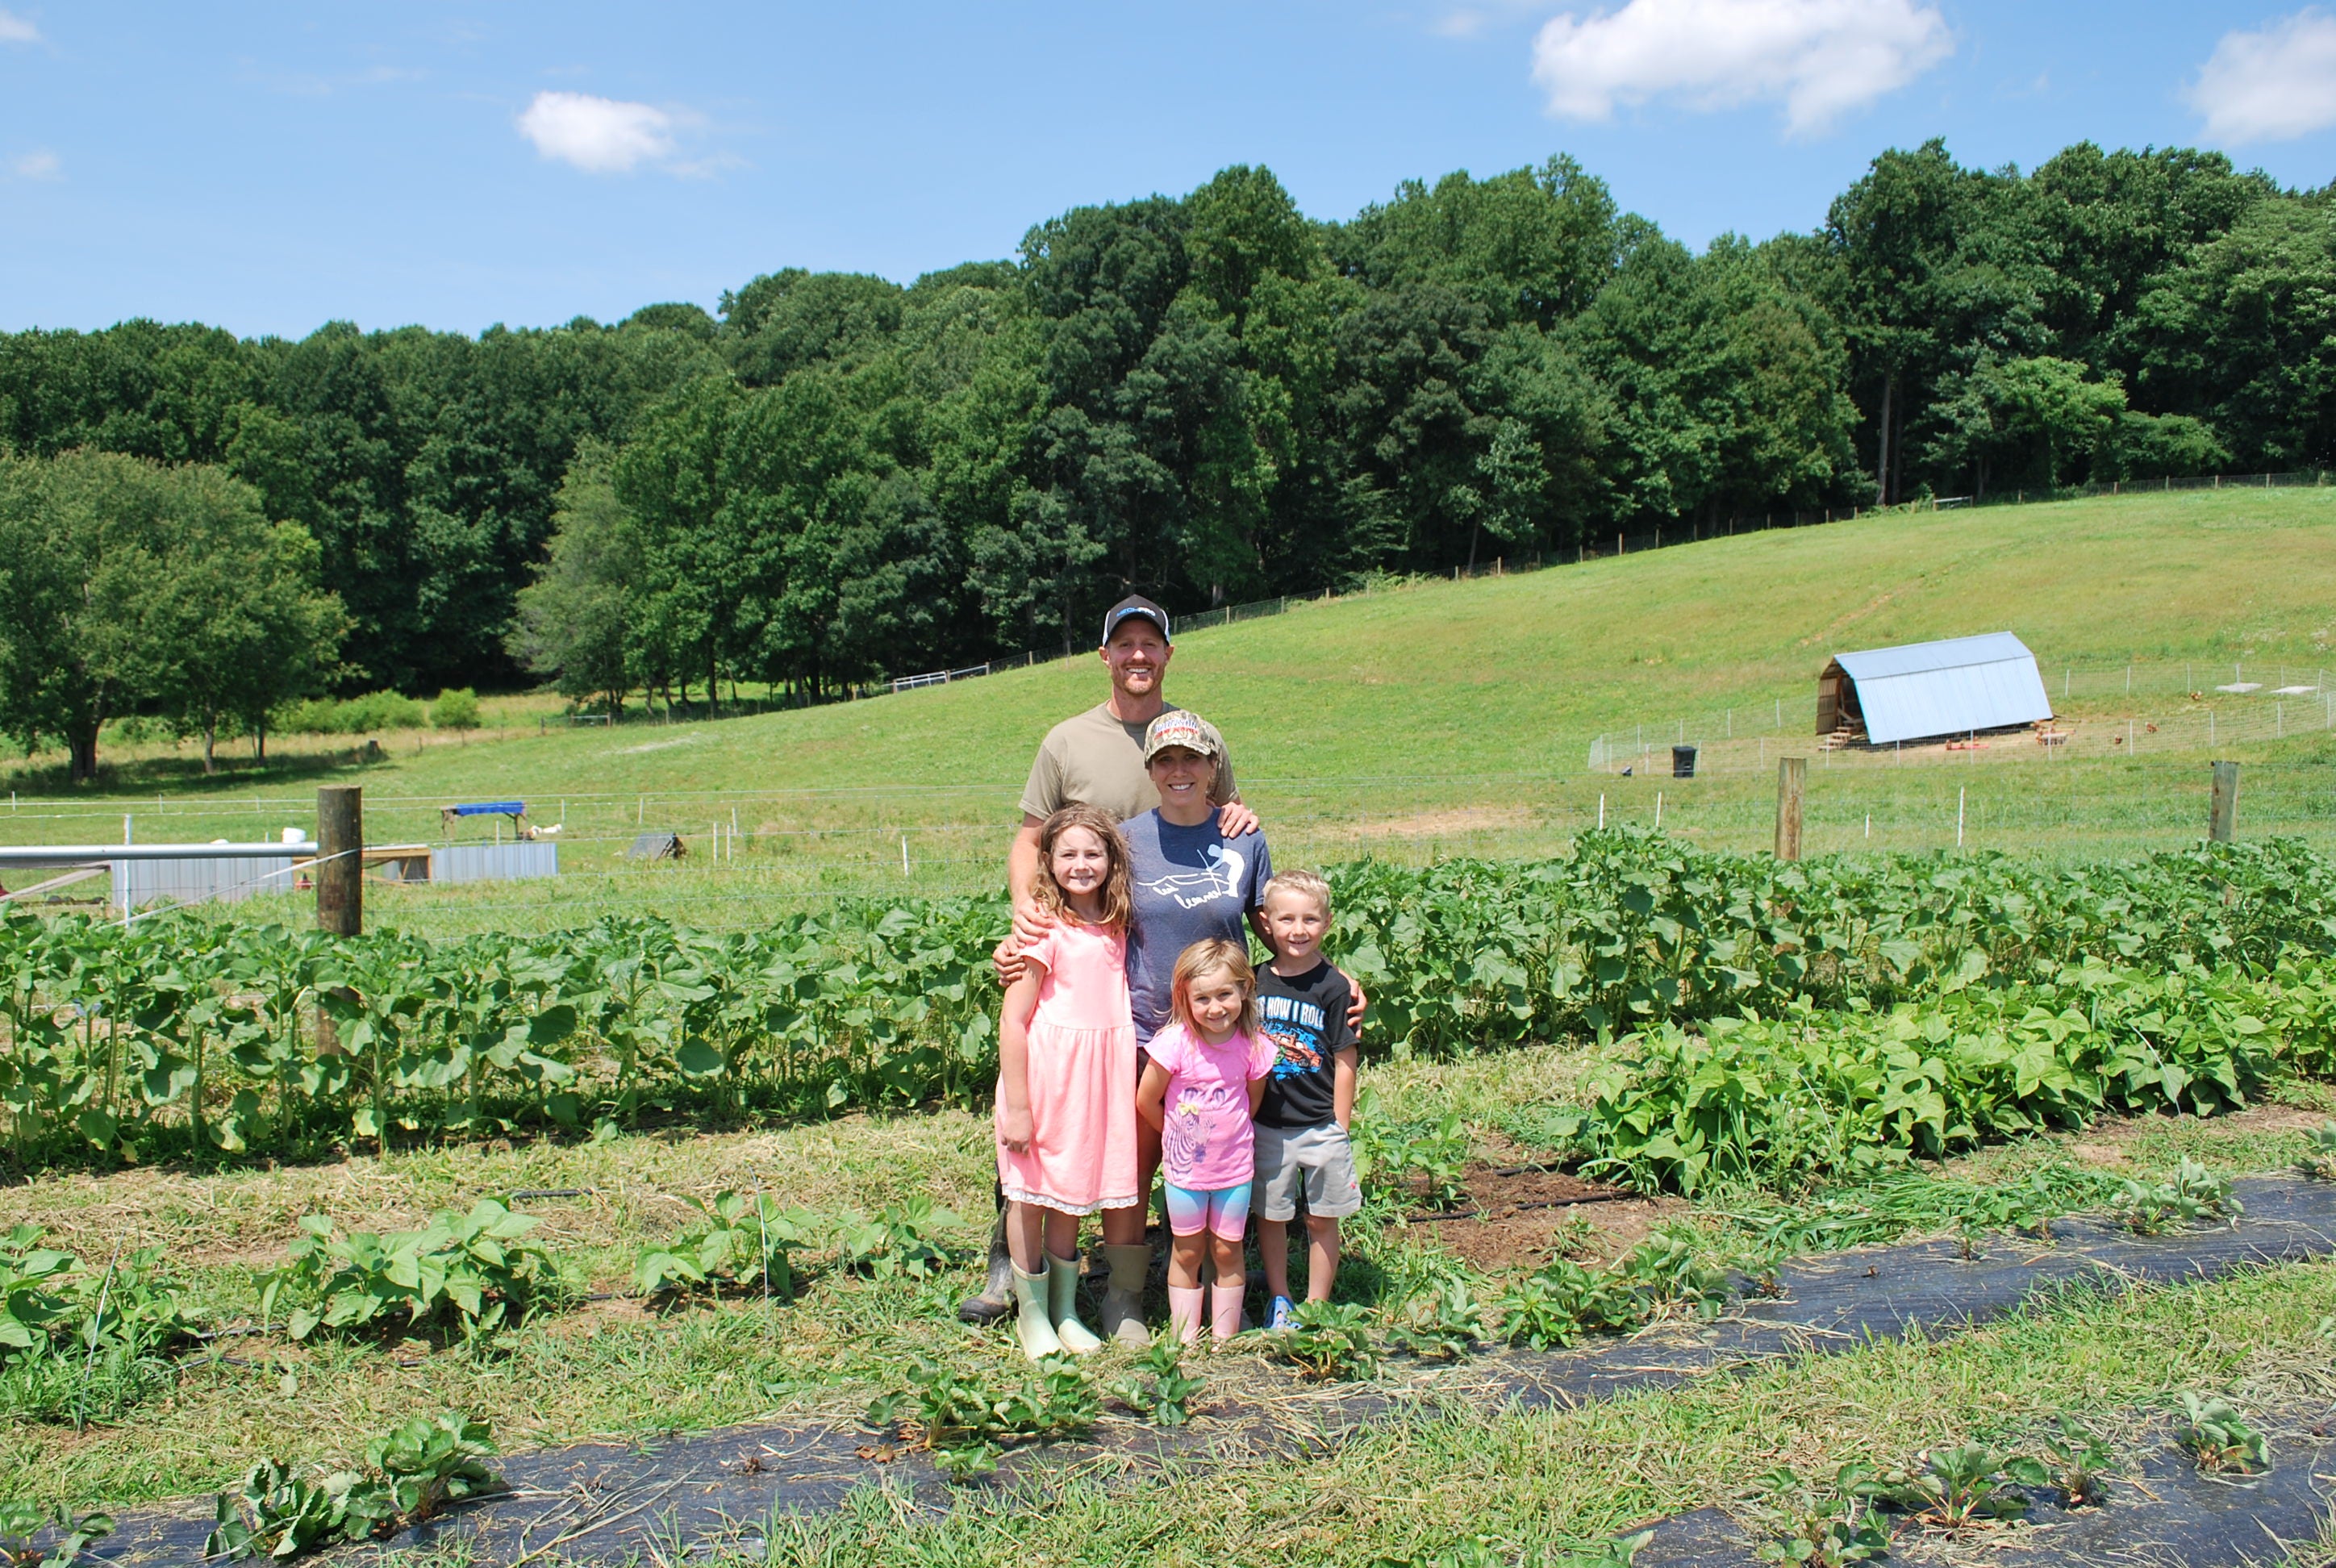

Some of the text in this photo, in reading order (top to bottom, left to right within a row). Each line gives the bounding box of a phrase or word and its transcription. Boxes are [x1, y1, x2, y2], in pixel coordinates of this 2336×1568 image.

[1266, 995, 1292, 1020] HOW
[1292, 1000, 1299, 1023] I
[1299, 1003, 1325, 1031] ROLL
